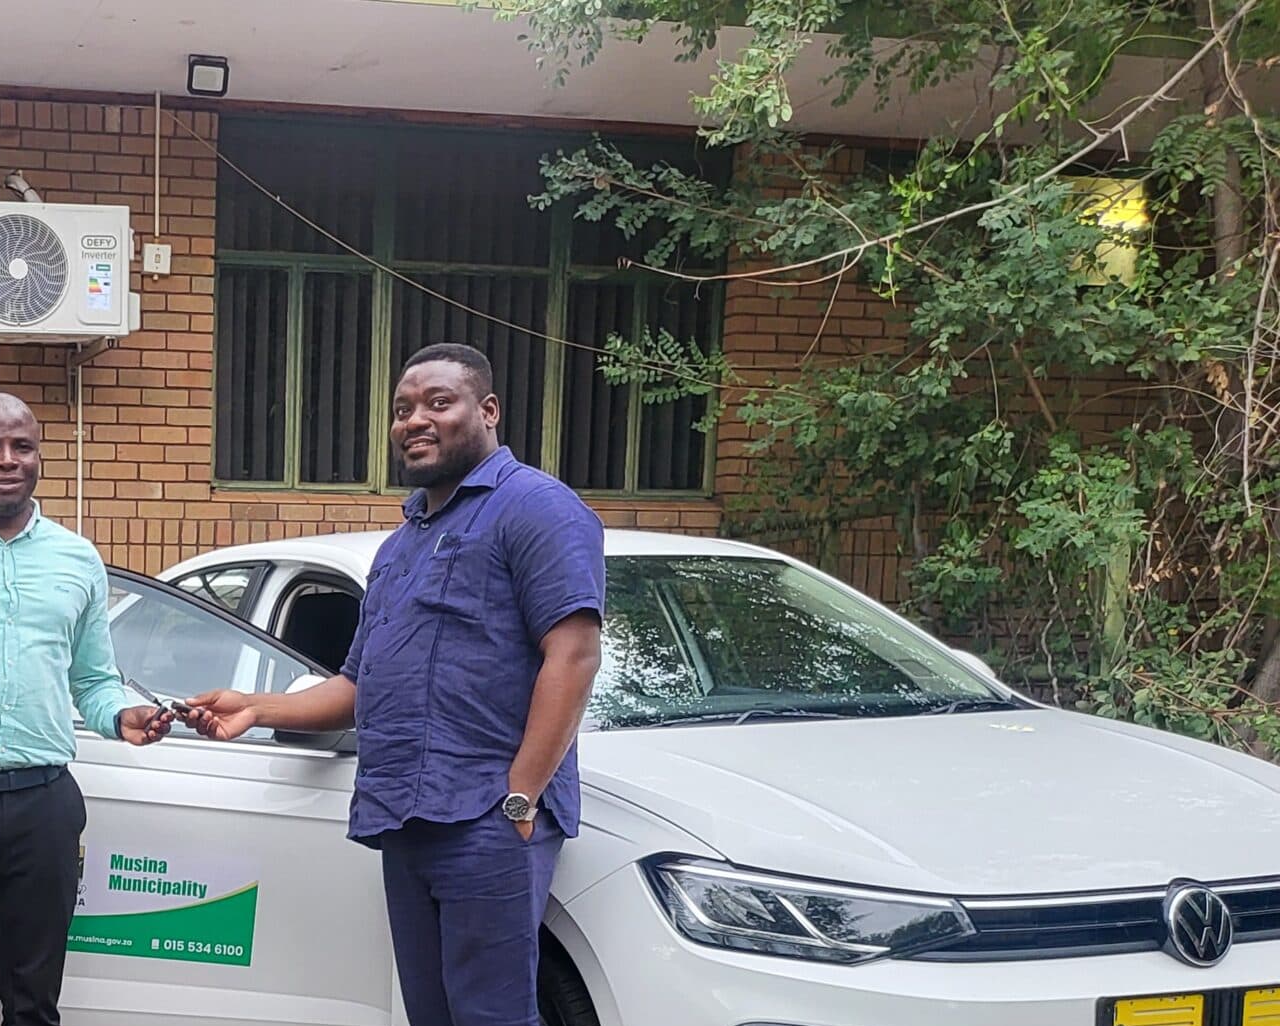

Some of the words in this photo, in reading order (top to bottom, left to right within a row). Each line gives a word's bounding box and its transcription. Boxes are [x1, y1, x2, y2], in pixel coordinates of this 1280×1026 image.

[86, 239, 112, 247] DEFY
[81, 250, 116, 260] Inverter
[110, 854, 167, 874] Musina
[108, 874, 207, 899] Municipality
[163, 939, 185, 951] 015
[187, 942, 211, 954] 534
[214, 944, 244, 956] 6100
